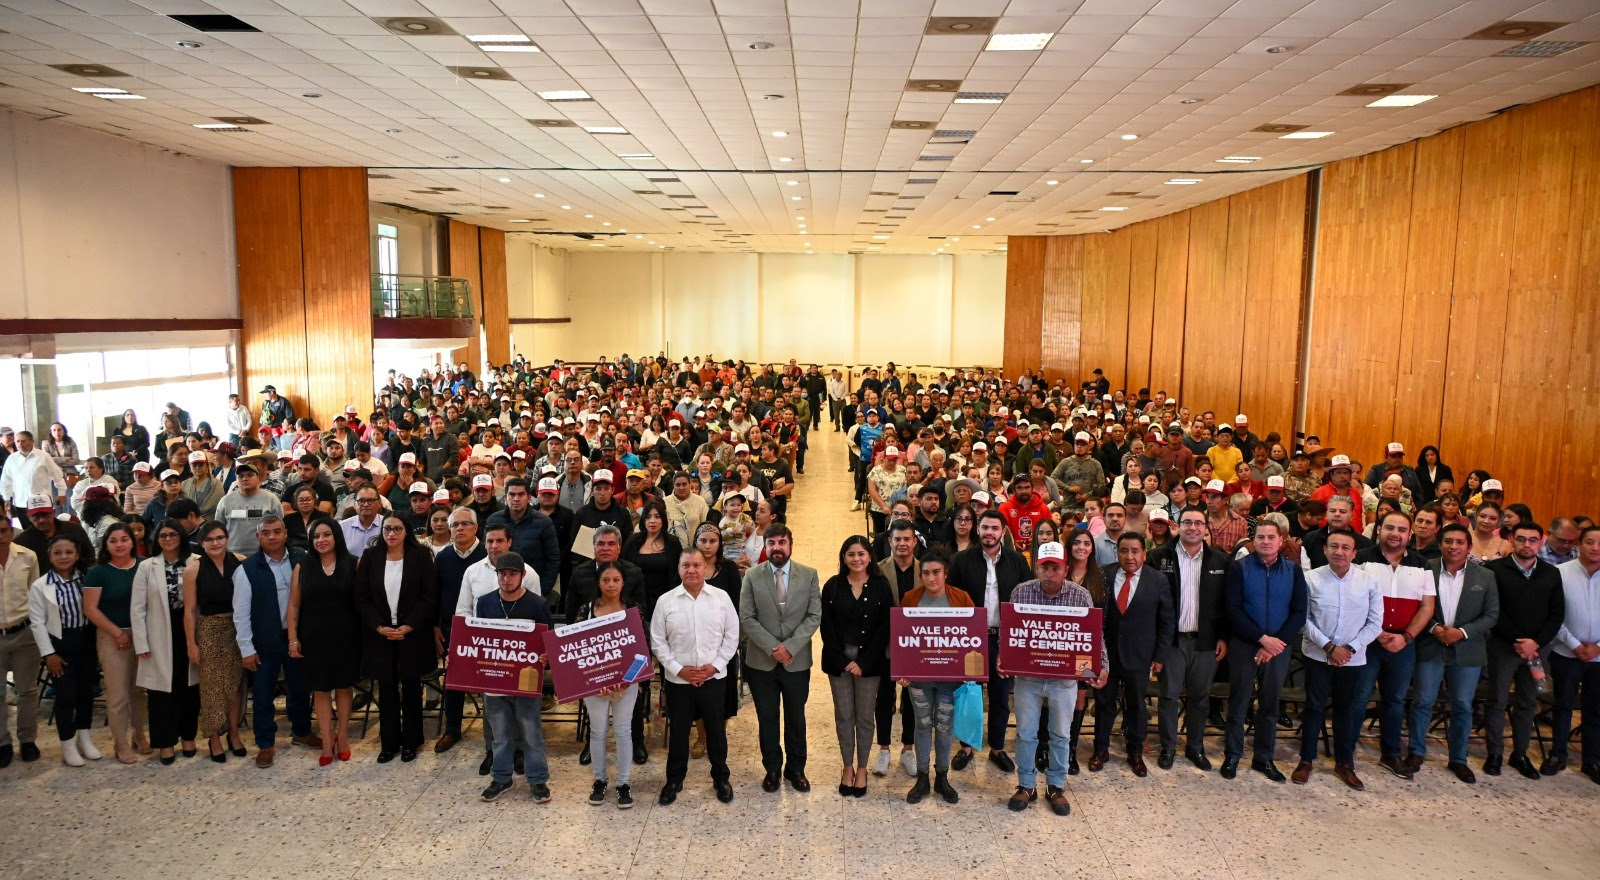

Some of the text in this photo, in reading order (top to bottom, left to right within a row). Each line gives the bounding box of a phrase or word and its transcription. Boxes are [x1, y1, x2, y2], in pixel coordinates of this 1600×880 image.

[911, 626, 968, 635] VALE POR
[1022, 619, 1080, 632] VALE POR
[560, 627, 630, 653] VALE POR UN
[898, 636, 982, 648] UN TINACO
[1009, 627, 1092, 642] UN PAQUETE
[472, 636, 526, 649] VALE POR
[558, 634, 636, 663] CALENTADOR
[1009, 637, 1093, 652] DE CEMENTO
[457, 645, 539, 663] UN TINACO
[577, 649, 622, 669] SOLAR
